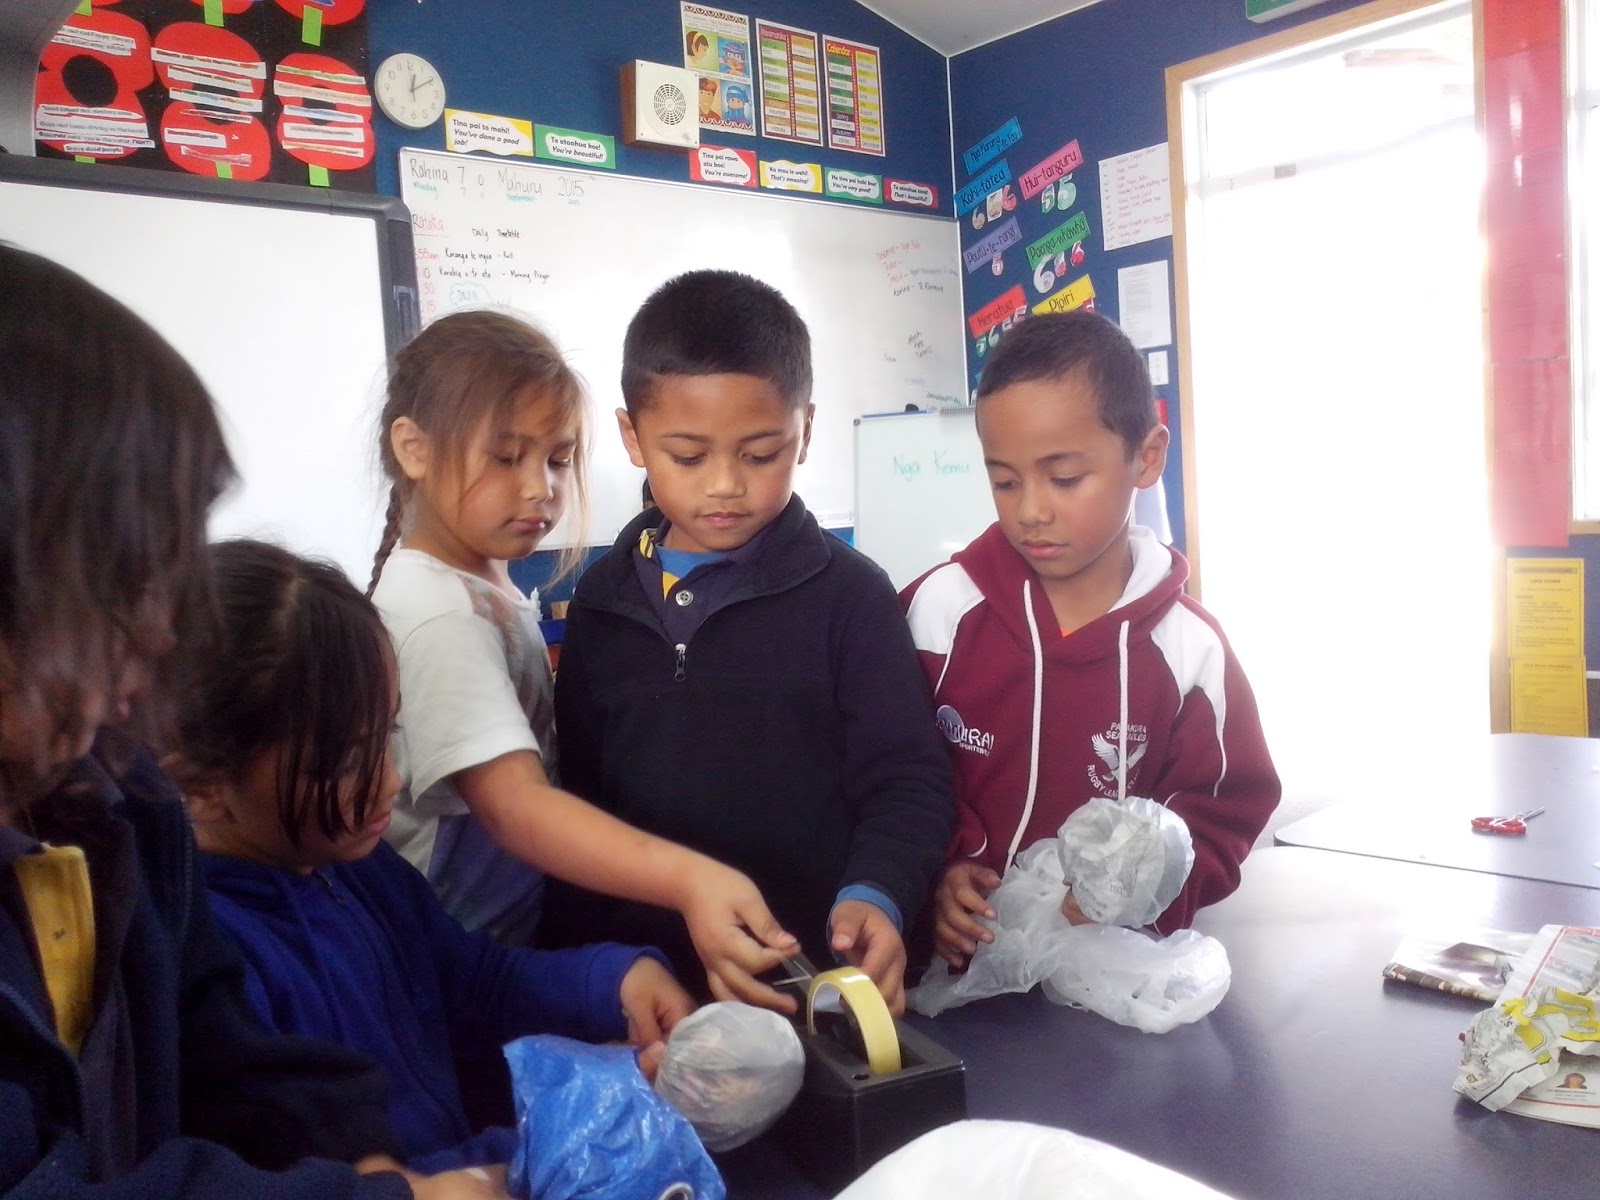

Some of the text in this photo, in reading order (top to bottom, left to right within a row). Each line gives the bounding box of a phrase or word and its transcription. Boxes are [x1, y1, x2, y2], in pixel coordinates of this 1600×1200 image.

[826, 43, 850, 56] Calendar
[452, 119, 468, 127] Tino
[490, 126, 510, 134] mahi!
[454, 128, 478, 138] You've
[479, 133, 495, 141] done
[551, 136, 558, 144] Te
[560, 139, 587, 149] ataahua
[552, 146, 604, 160] You're beautiful!
[704, 169, 748, 179] You're awesome!
[770, 174, 786, 182] That's
[1024, 151, 1077, 193] Hui-tanguru
[457, 166, 465, 184] 7
[557, 175, 584, 197] 2015
[833, 182, 848, 190] You're
[471, 228, 520, 241] Daily Timetable
[1033, 254, 1055, 294] 6
[1049, 290, 1075, 312] Pipiri
[1087, 764, 1106, 791] RUGBY
